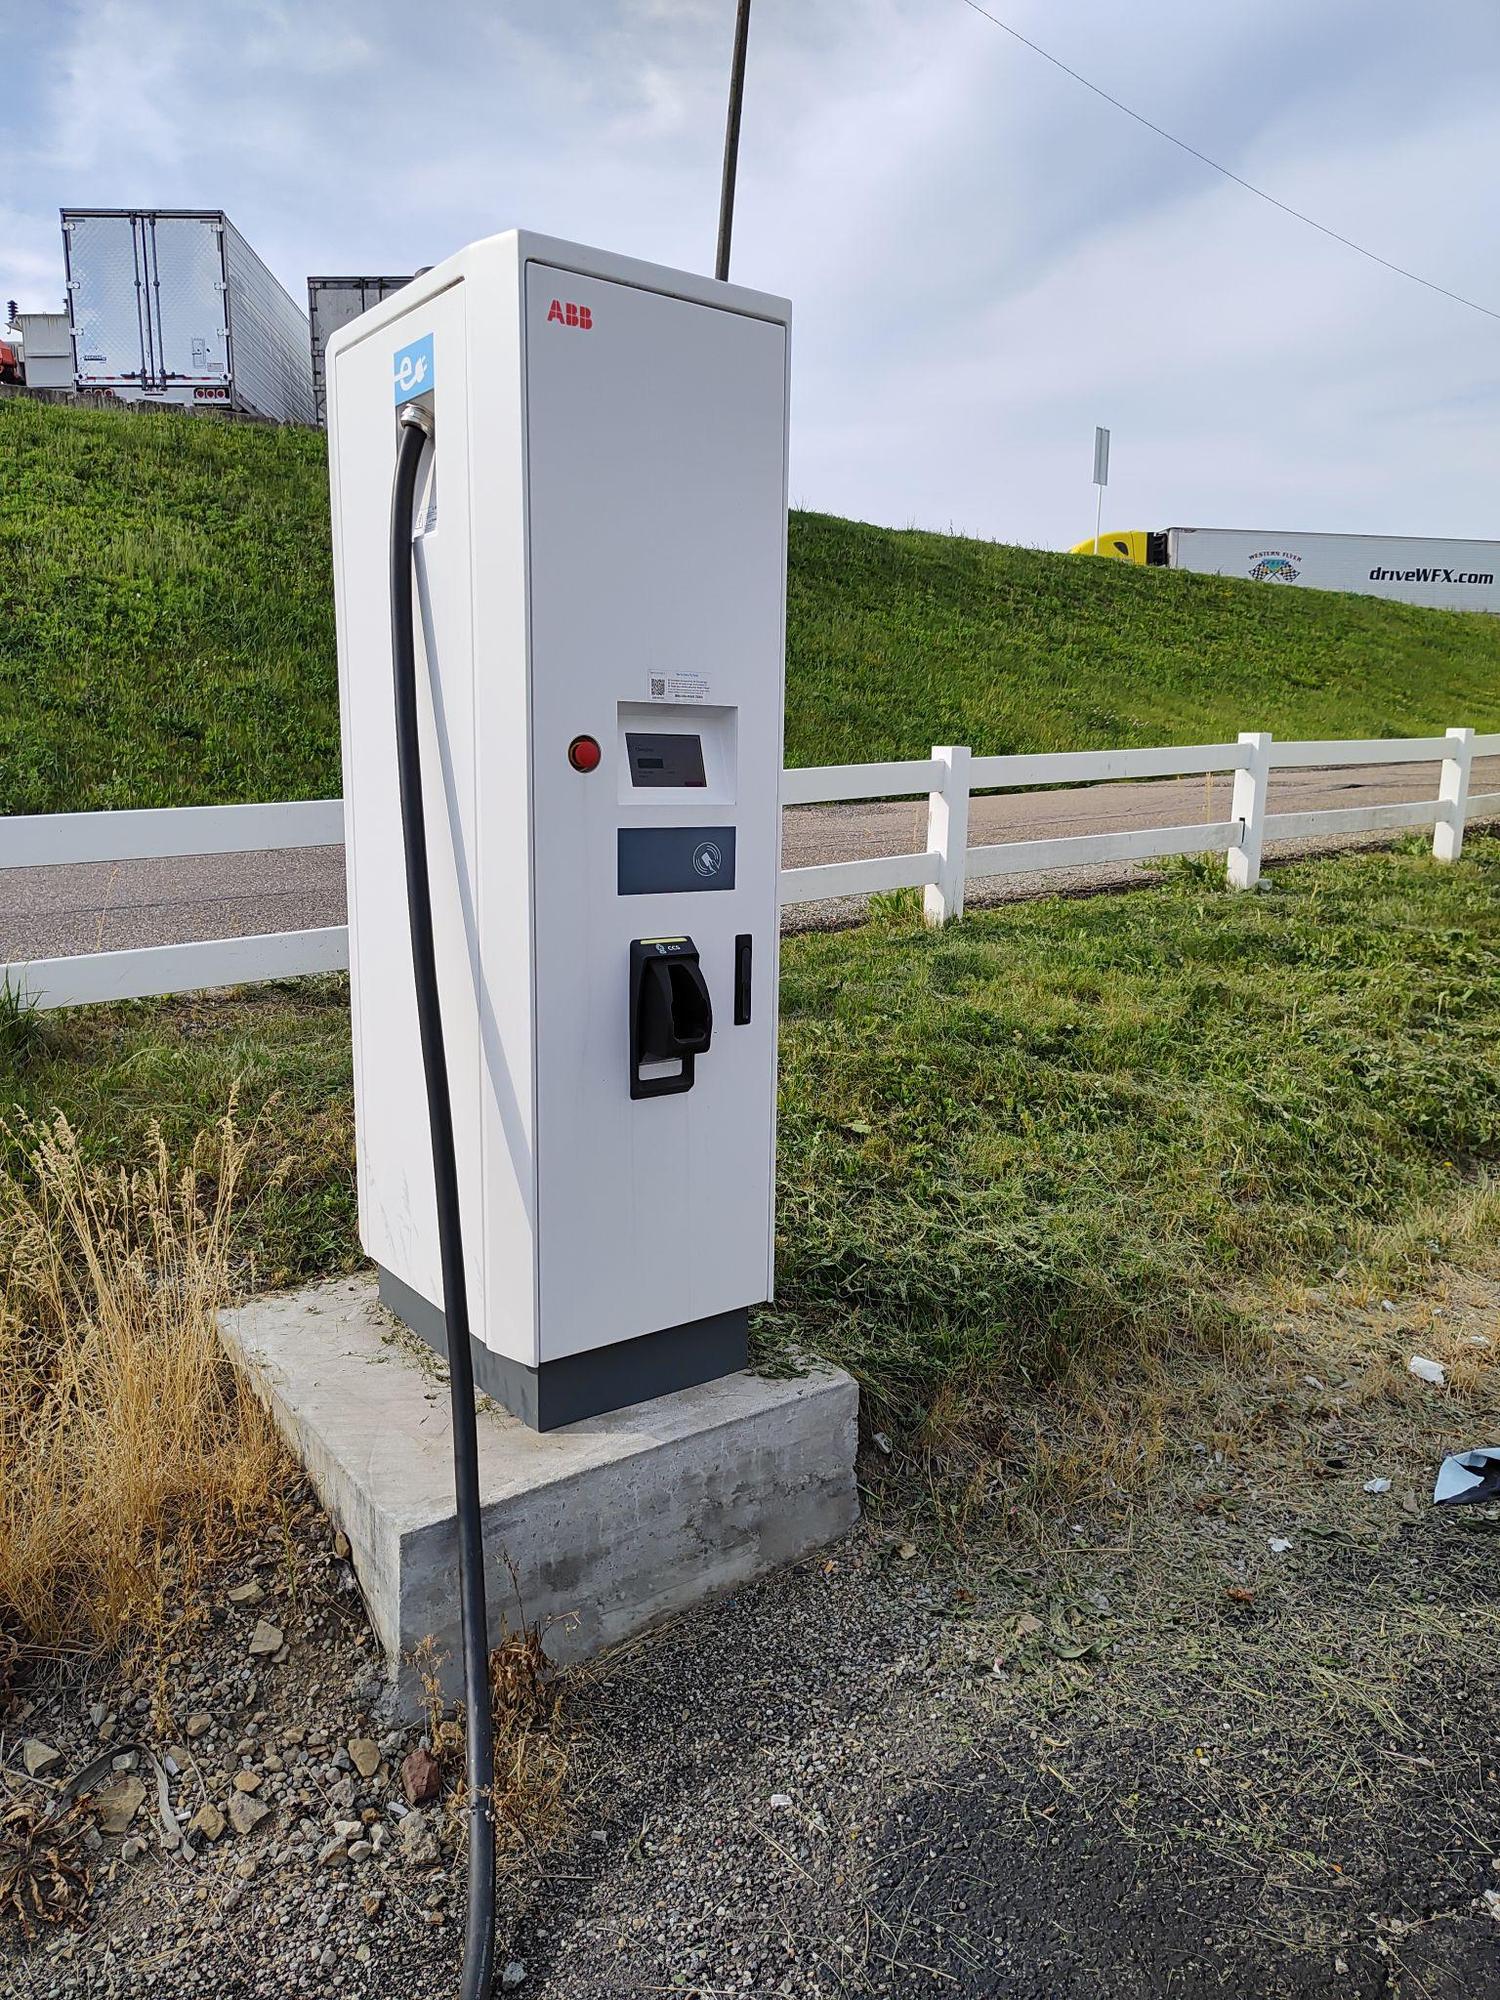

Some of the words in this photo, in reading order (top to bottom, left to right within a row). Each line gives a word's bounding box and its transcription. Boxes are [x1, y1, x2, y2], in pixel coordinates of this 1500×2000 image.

[547, 299, 593, 330] ABB
[1248, 551, 1280, 560] WESTERN
[1369, 566, 1494, 584] driveWFX.com
